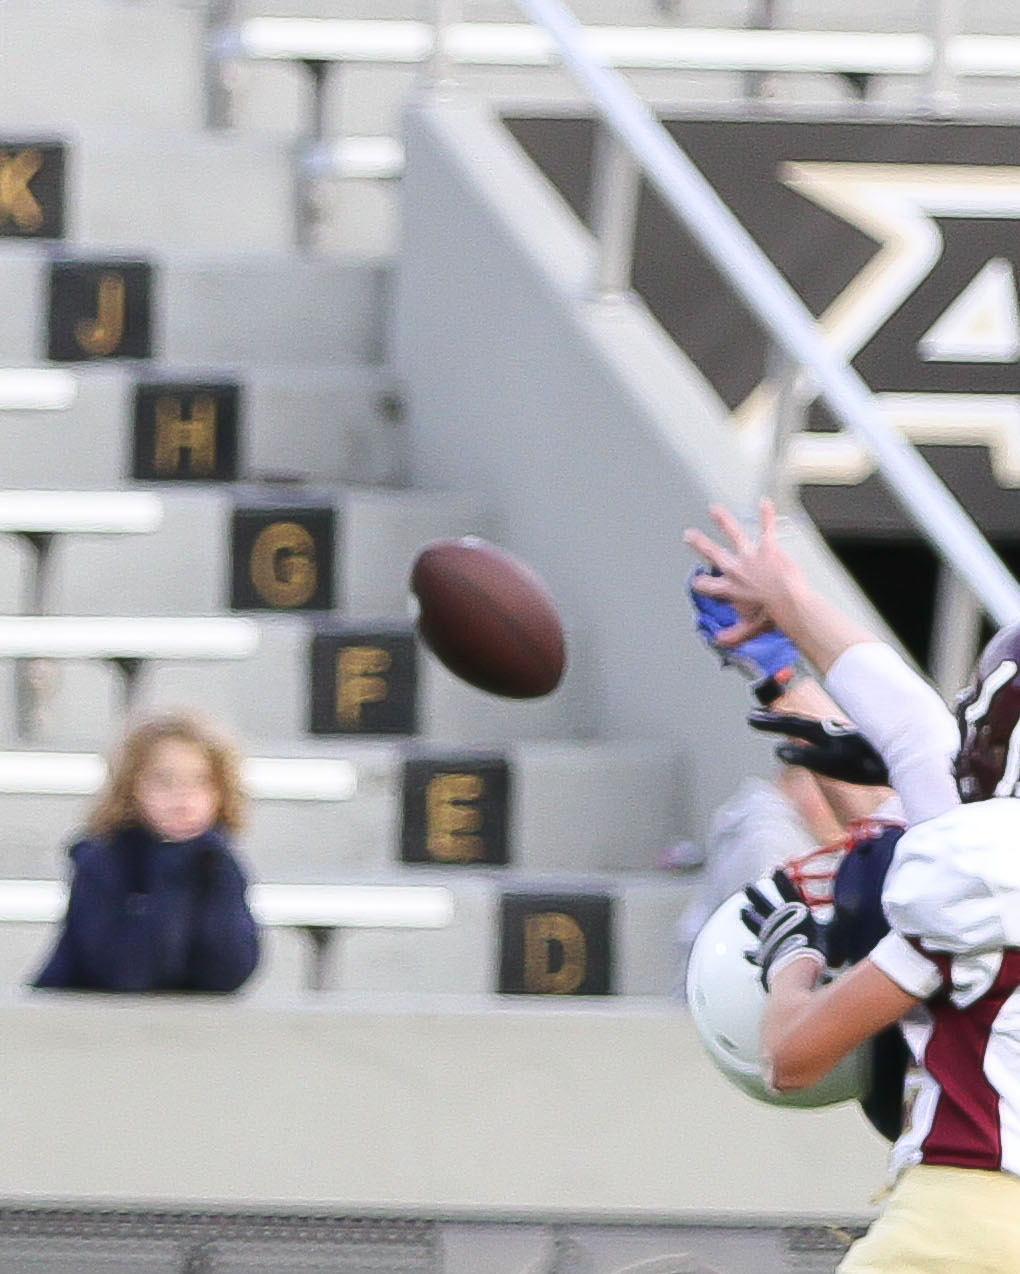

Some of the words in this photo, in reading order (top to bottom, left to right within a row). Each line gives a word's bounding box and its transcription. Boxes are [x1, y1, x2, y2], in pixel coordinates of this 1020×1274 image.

[74, 271, 127, 357] J
[153, 395, 219, 476] H
[249, 521, 319, 608] G
[334, 645, 394, 728] F
[425, 773, 487, 862] E
[523, 911, 589, 994] D
